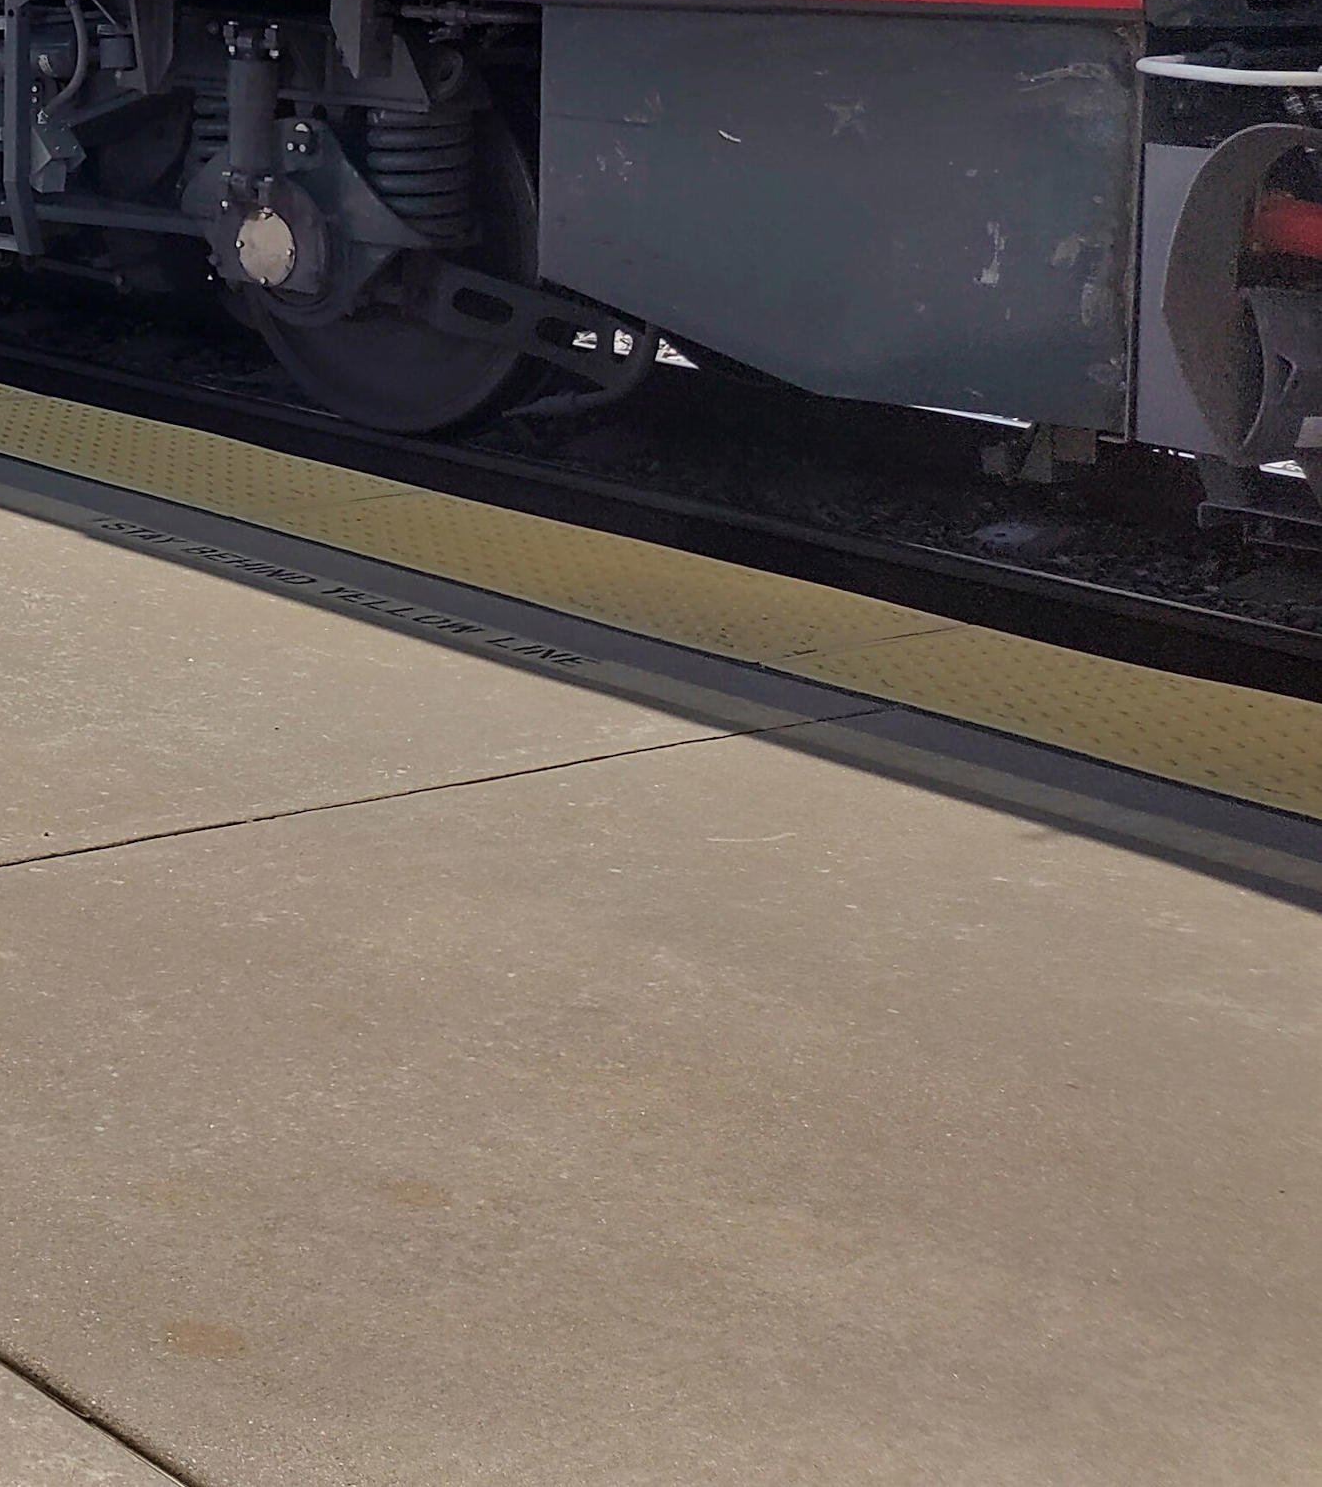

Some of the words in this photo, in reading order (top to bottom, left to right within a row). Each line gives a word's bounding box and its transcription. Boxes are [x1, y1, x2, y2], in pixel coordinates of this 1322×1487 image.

[101, 521, 188, 545] STAY
[181, 546, 317, 584] BEHIND
[320, 585, 485, 634] YELLOW
[486, 636, 591, 666] LINE
